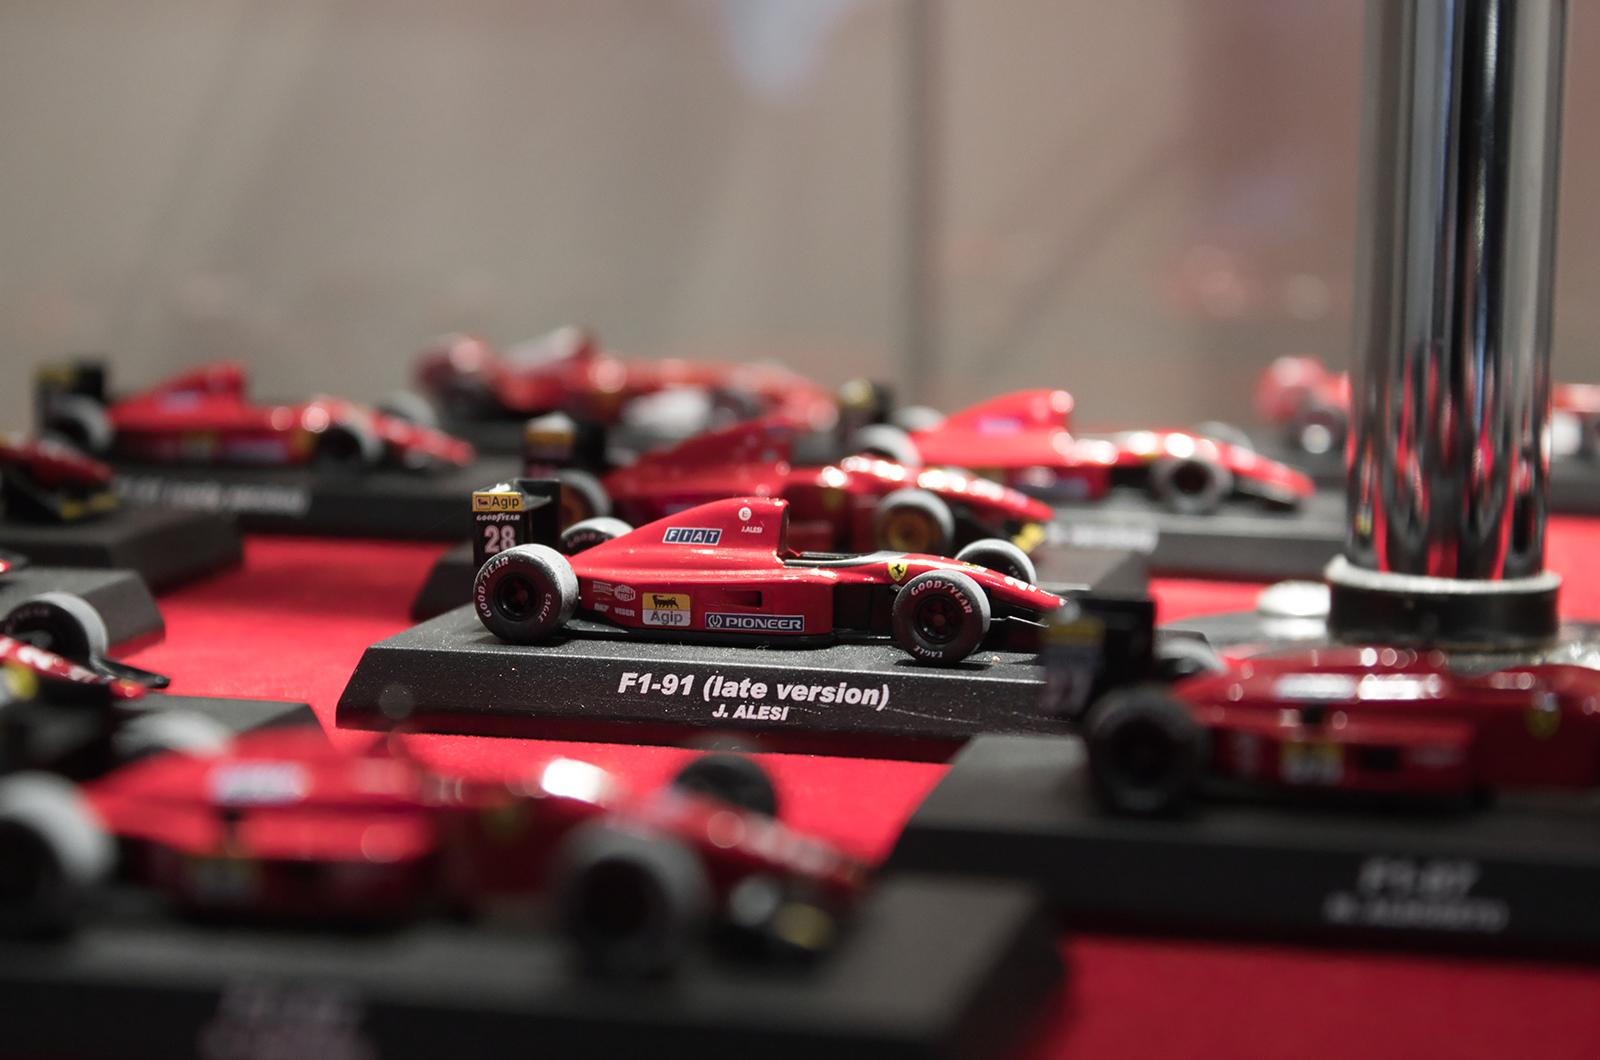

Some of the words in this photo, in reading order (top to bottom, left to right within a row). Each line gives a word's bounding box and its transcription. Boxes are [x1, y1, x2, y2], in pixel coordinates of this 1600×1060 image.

[491, 496, 520, 510] Agip
[476, 512, 520, 523] GOODYEAR
[484, 525, 516, 553] 28
[666, 529, 719, 543] FIAT
[477, 556, 509, 618] GOODYEAR
[910, 579, 973, 614] GOODYEAR
[538, 593, 552, 623] EAGLE
[650, 610, 683, 625] Agip
[725, 617, 802, 630] PIONEER
[913, 645, 943, 659] EAGLE
[618, 672, 695, 696] F1-91
[703, 675, 768, 702] (late
[776, 682, 890, 712] version)
[712, 704, 729, 719] J.
[734, 705, 789, 721] ALESI
